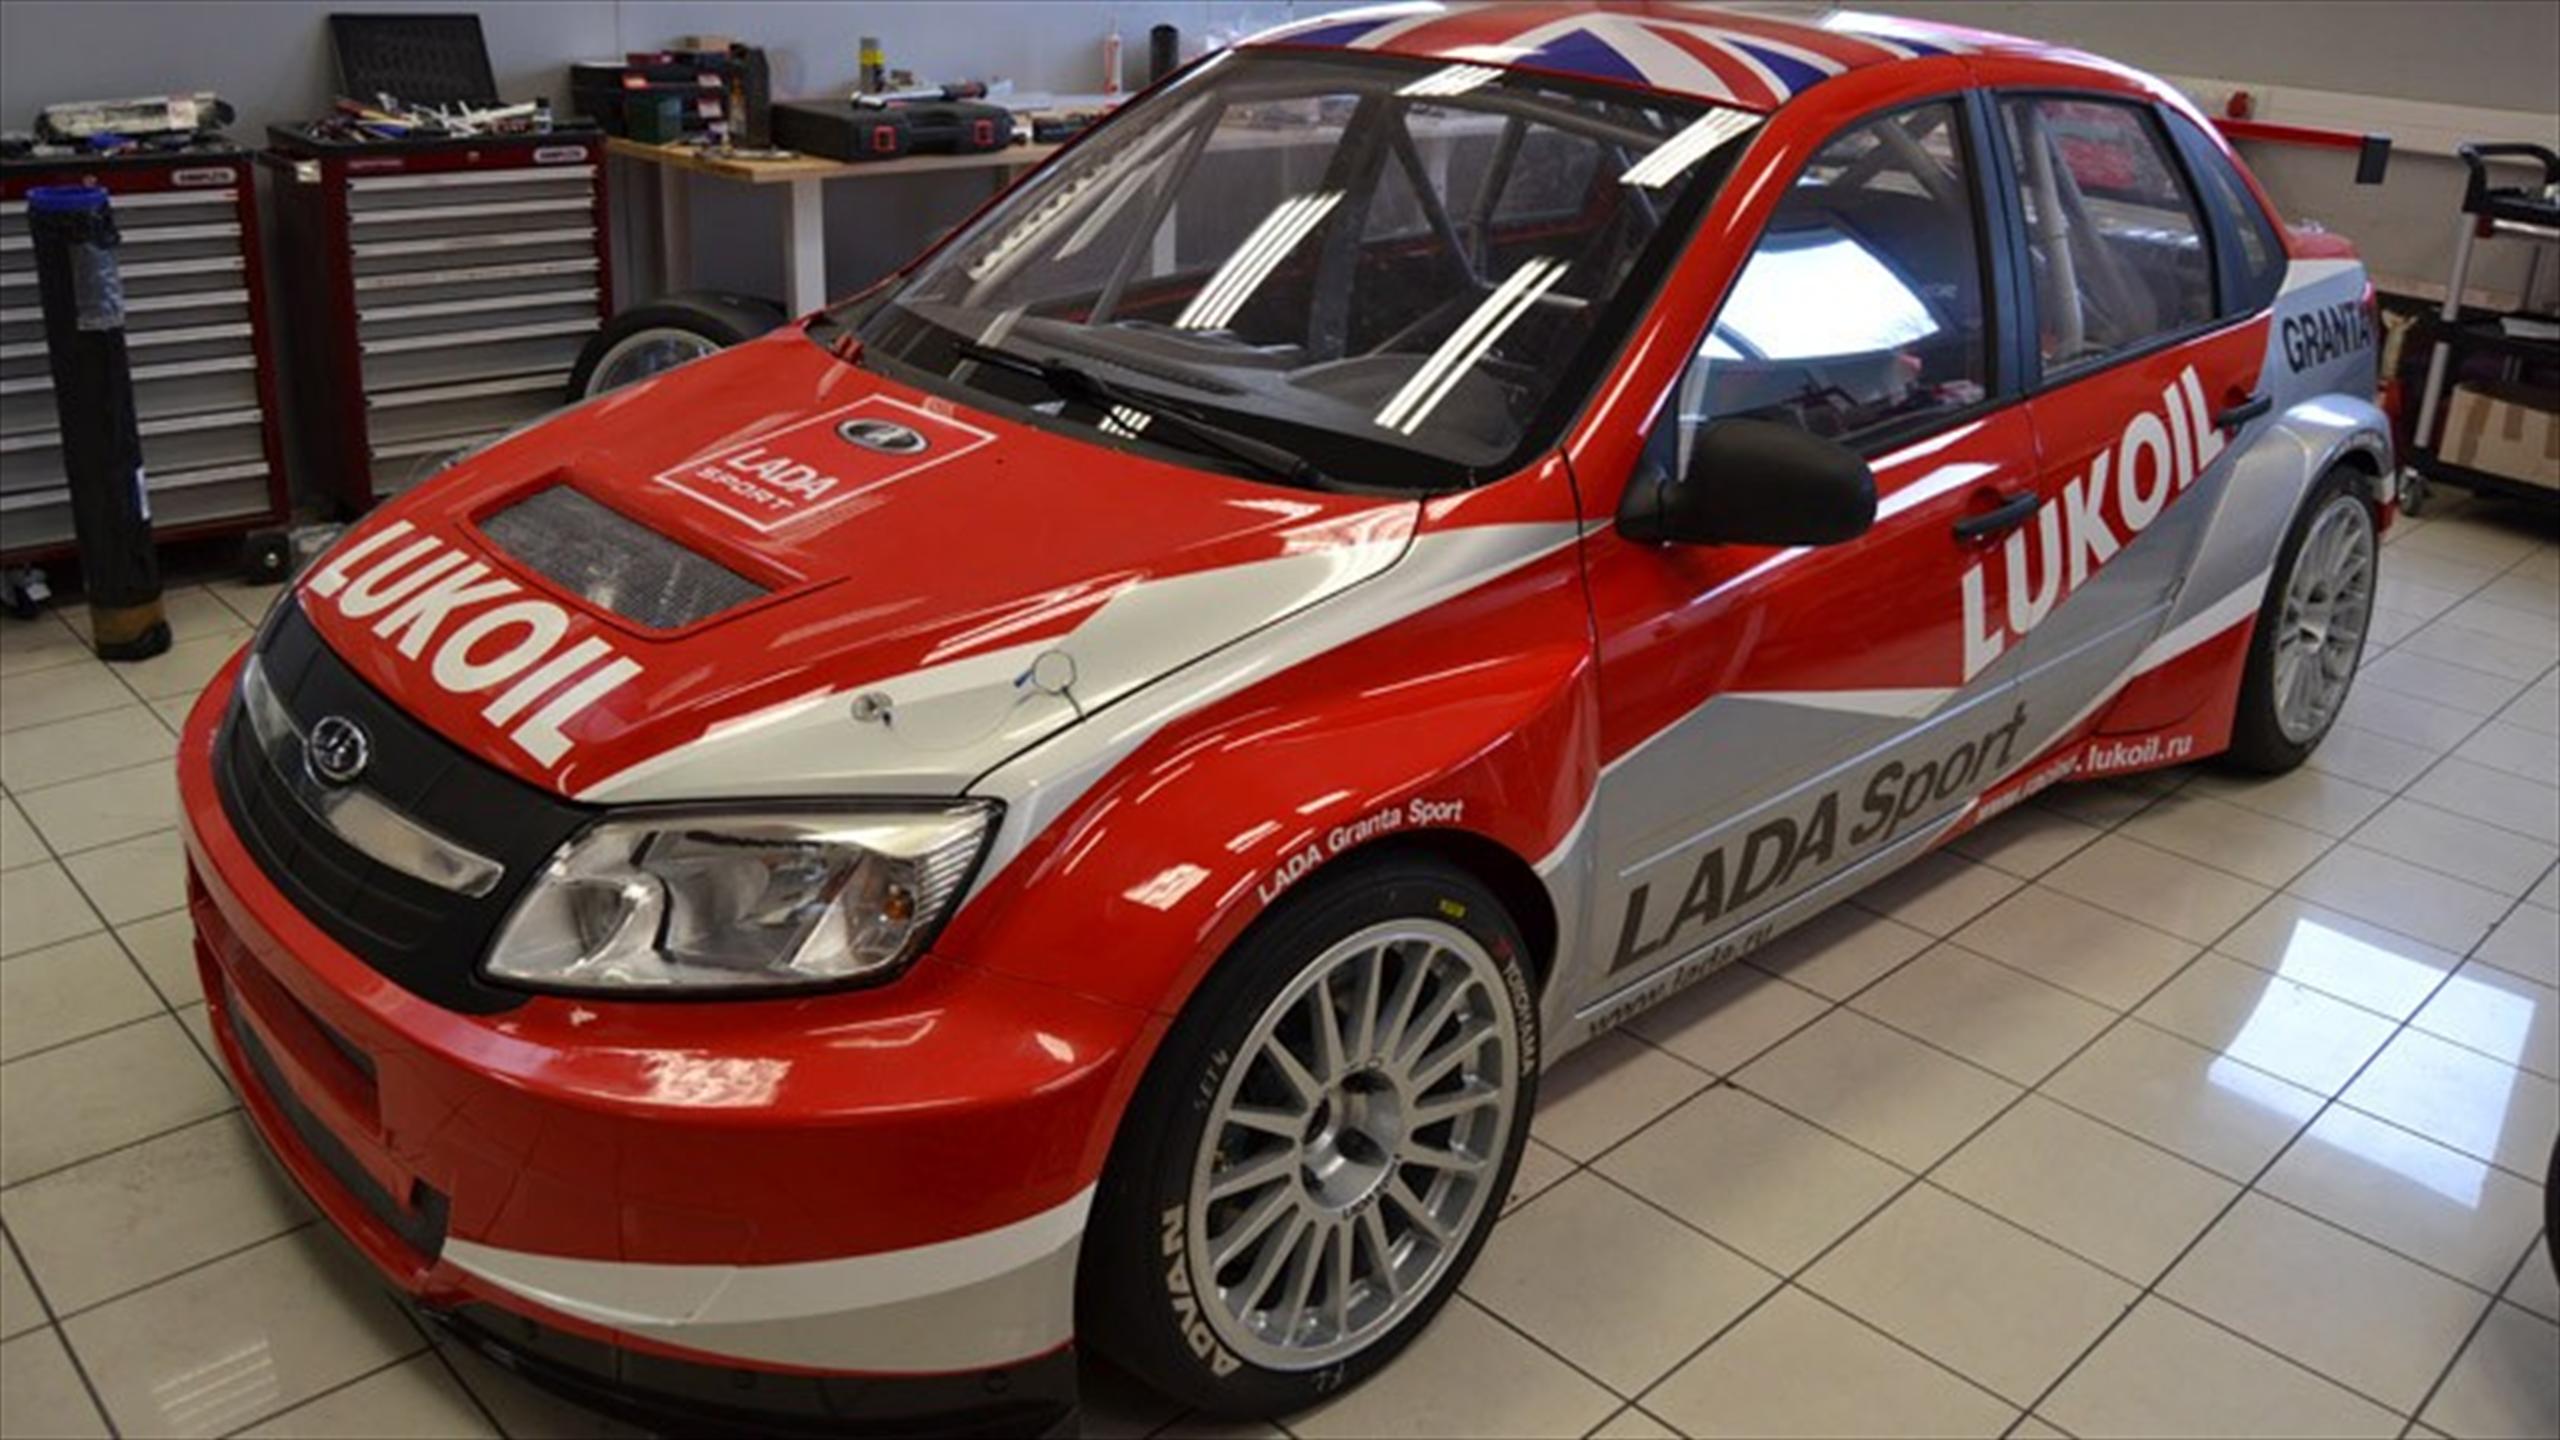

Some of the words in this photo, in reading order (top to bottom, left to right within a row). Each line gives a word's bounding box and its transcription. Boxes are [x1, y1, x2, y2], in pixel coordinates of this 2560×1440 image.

[2282, 301, 2372, 375] GRANTA
[696, 465, 796, 510] SPORT
[726, 447, 839, 500] LADA
[1961, 363, 2225, 684] LUKOIL
[307, 519, 644, 769] LUKOIL
[1257, 843, 1323, 905] LADA
[1327, 807, 1403, 852] Granta
[1408, 798, 1464, 825] Sport
[1607, 789, 1839, 976] LADA
[1849, 701, 2027, 848] Sport
[1502, 953, 1536, 1078] YOKOHAMA
[1162, 1203, 1242, 1378] ADVAN
